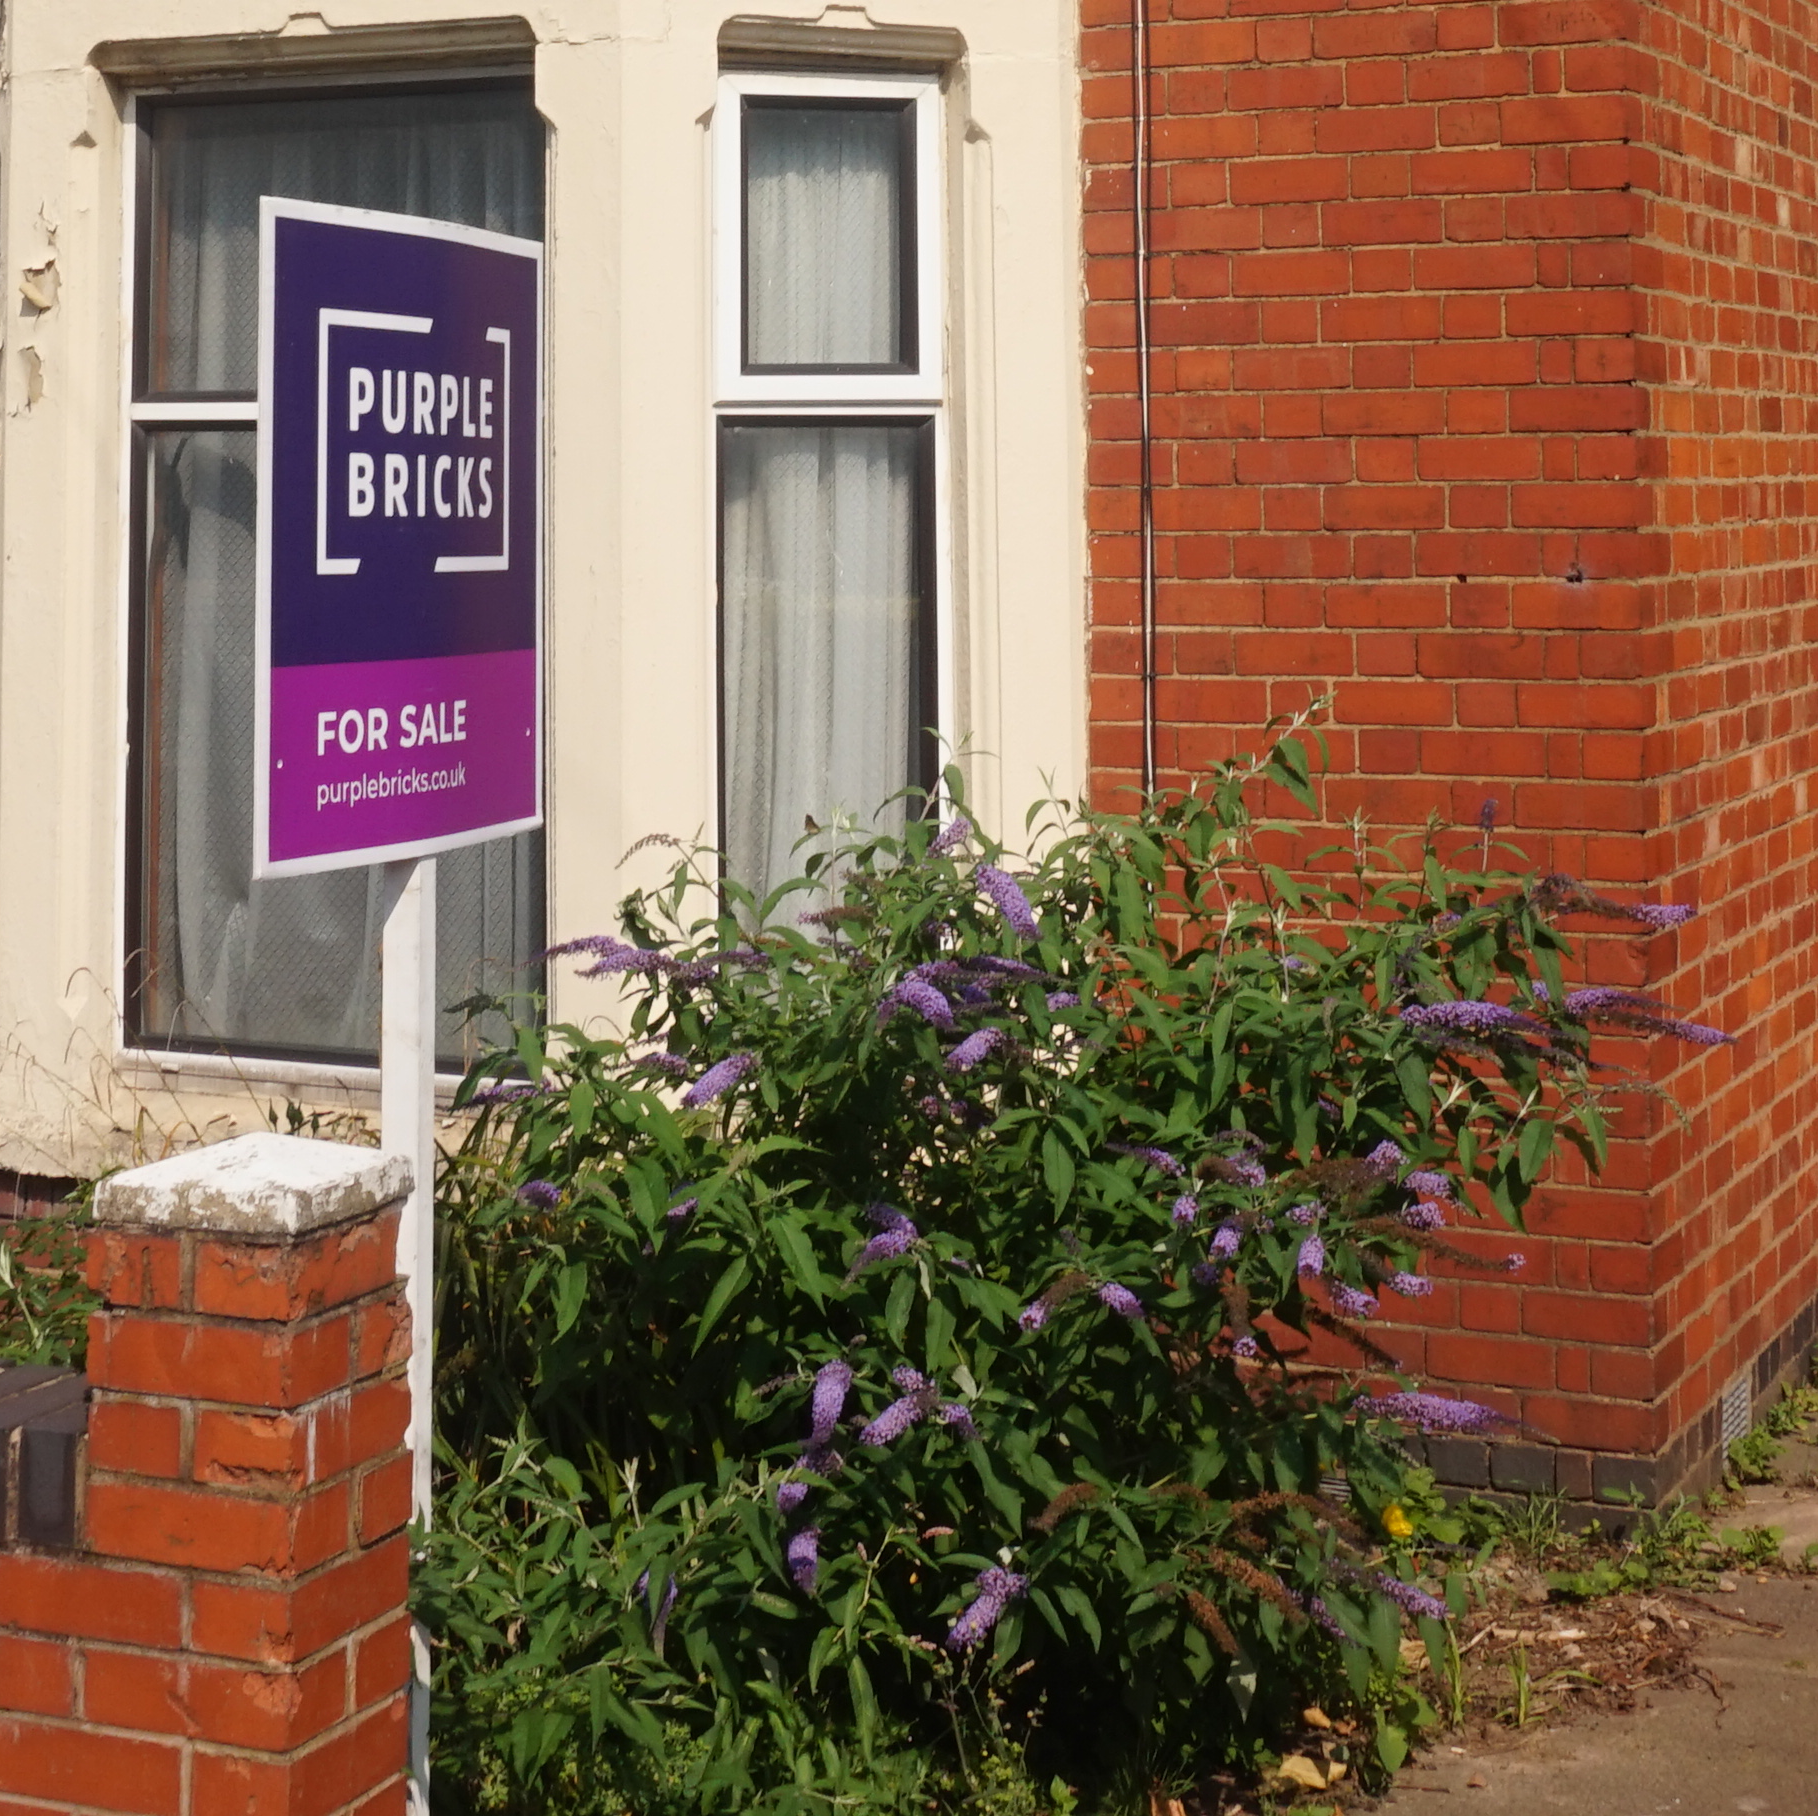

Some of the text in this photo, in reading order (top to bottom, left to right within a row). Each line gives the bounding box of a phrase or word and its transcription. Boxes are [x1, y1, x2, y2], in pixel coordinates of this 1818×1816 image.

[349, 366, 494, 440] PURPLE
[348, 451, 494, 519] BRICKS
[317, 699, 467, 757] FOR SALE
[316, 760, 467, 812] purplebricks.co.uk
